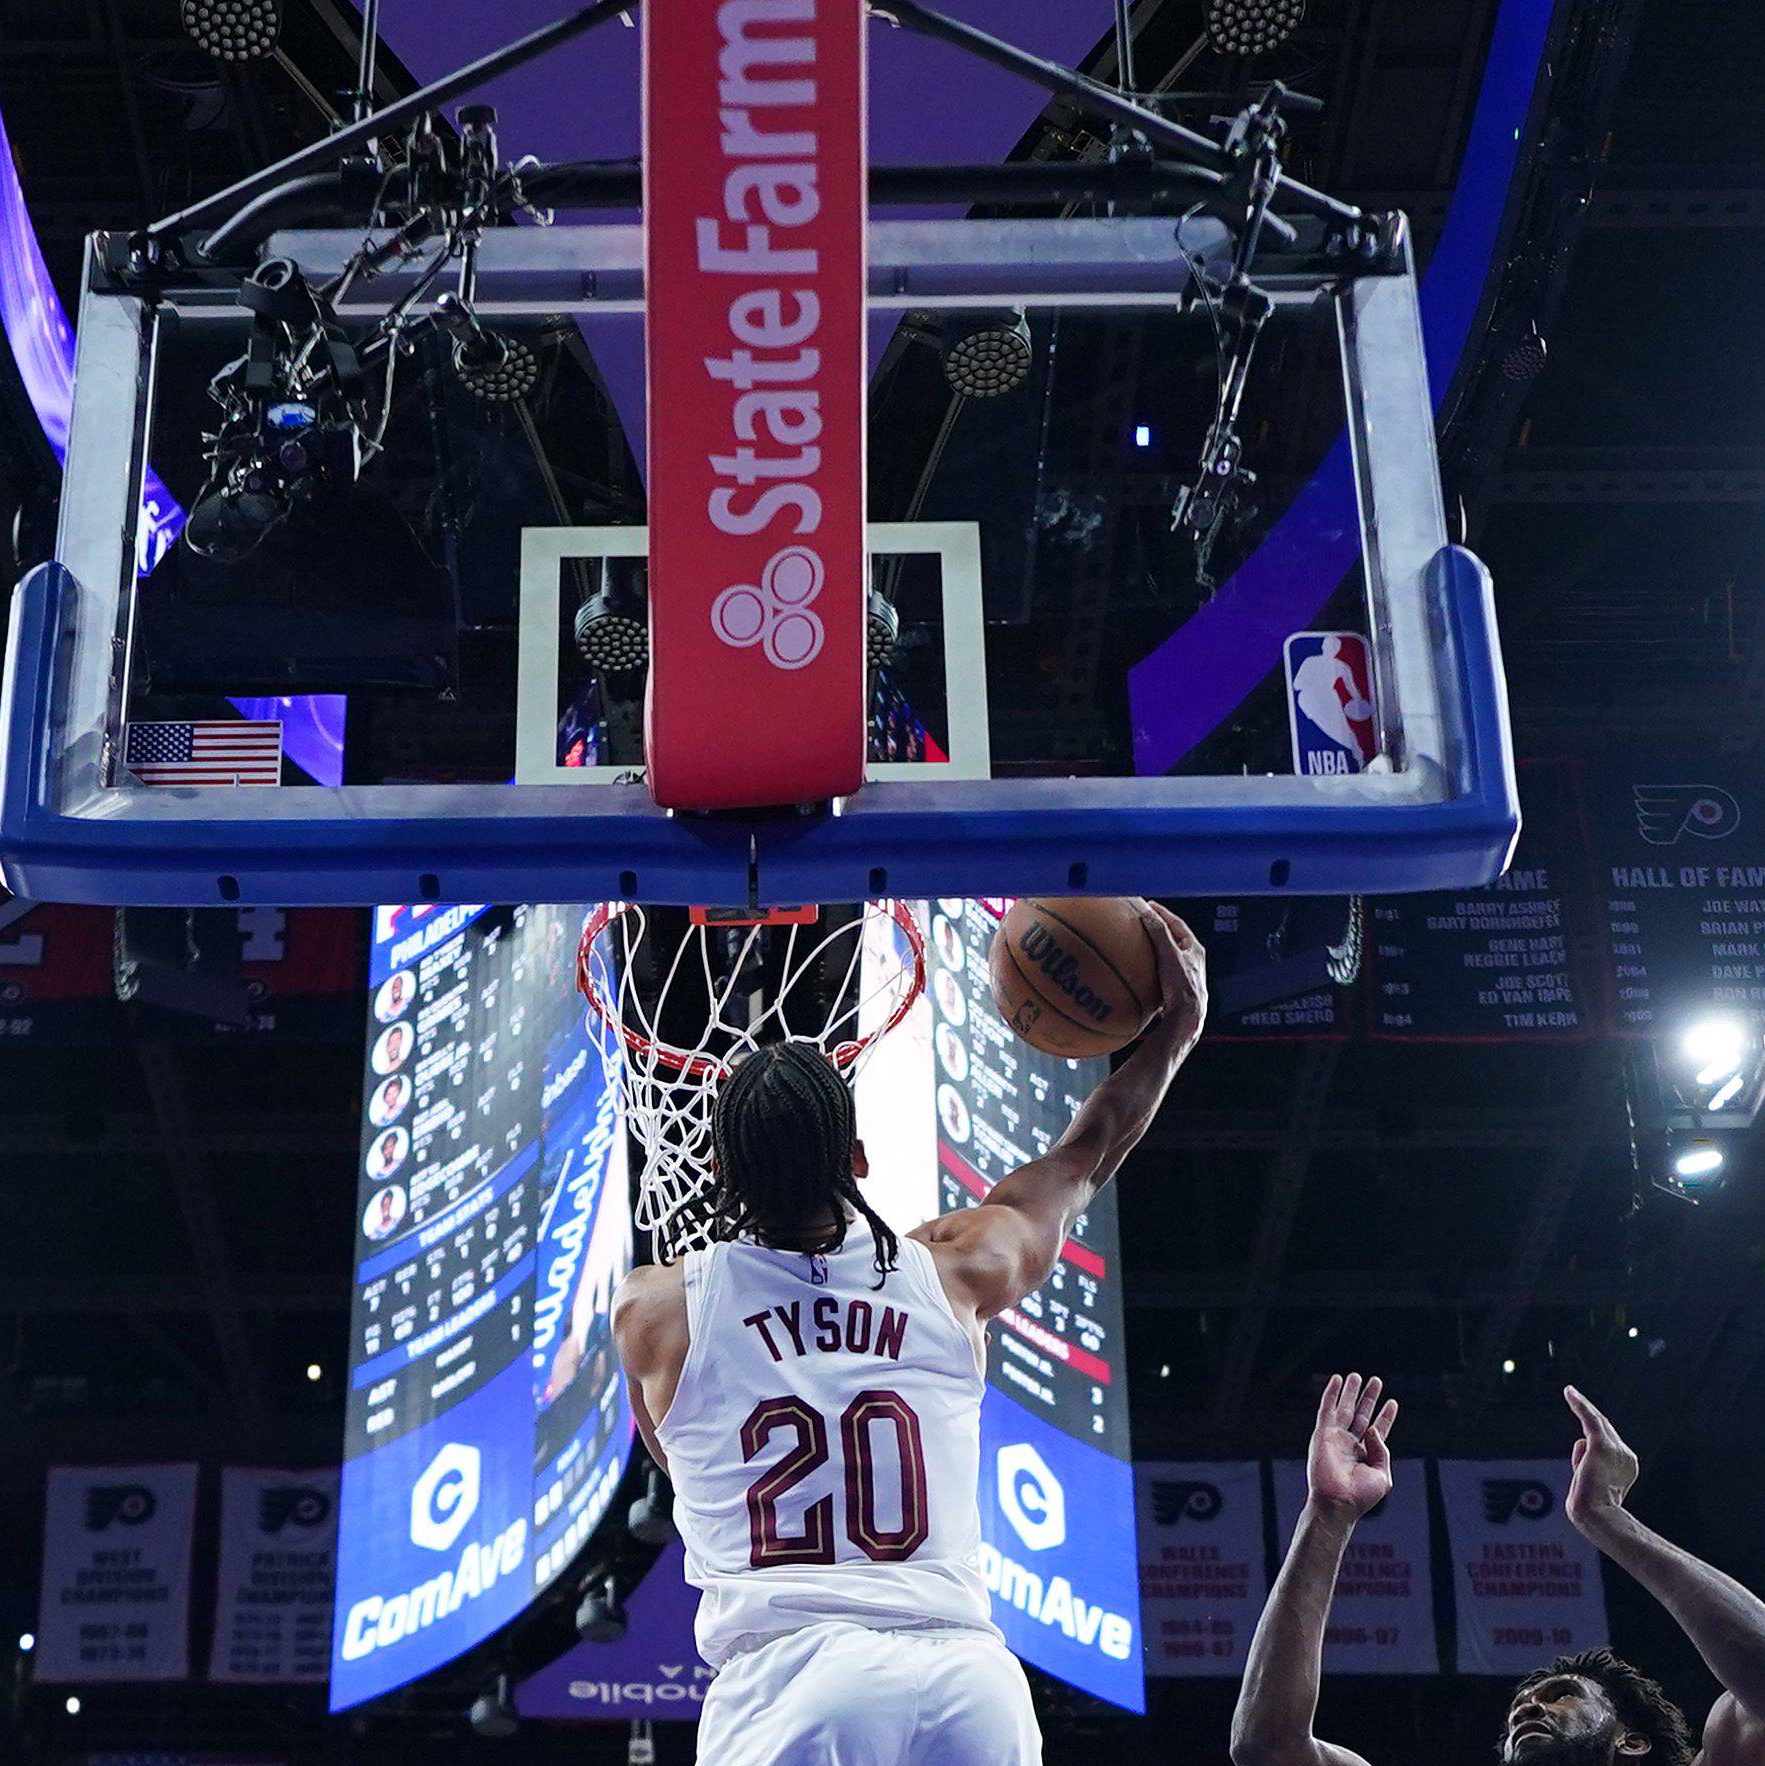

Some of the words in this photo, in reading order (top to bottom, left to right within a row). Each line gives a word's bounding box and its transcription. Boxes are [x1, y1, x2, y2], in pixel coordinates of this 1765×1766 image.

[1307, 750, 1349, 775] NBA
[1610, 866, 1674, 888] HALL
[1679, 866, 1710, 888] OF
[1702, 900, 1731, 913] JOE
[1700, 921, 1749, 935] BRIAN
[1712, 942, 1760, 958] MARK
[1020, 918, 1114, 1023] Wilson
[1502, 1013, 1535, 1028] TIM
[742, 1299, 909, 1364] TYSON
[740, 1389, 929, 1568] 20
[1162, 1545, 1221, 1561] WALES
[1481, 1543, 1565, 1560] EASTERN
[1467, 1561, 1583, 1580] CONFERENCE
[341, 1515, 528, 1663] ComAve
[1140, 1582, 1248, 1599] CHAMPIONS
[1473, 1580, 1583, 1599] CHAMPIONS
[977, 1543, 1132, 1662] omAve
